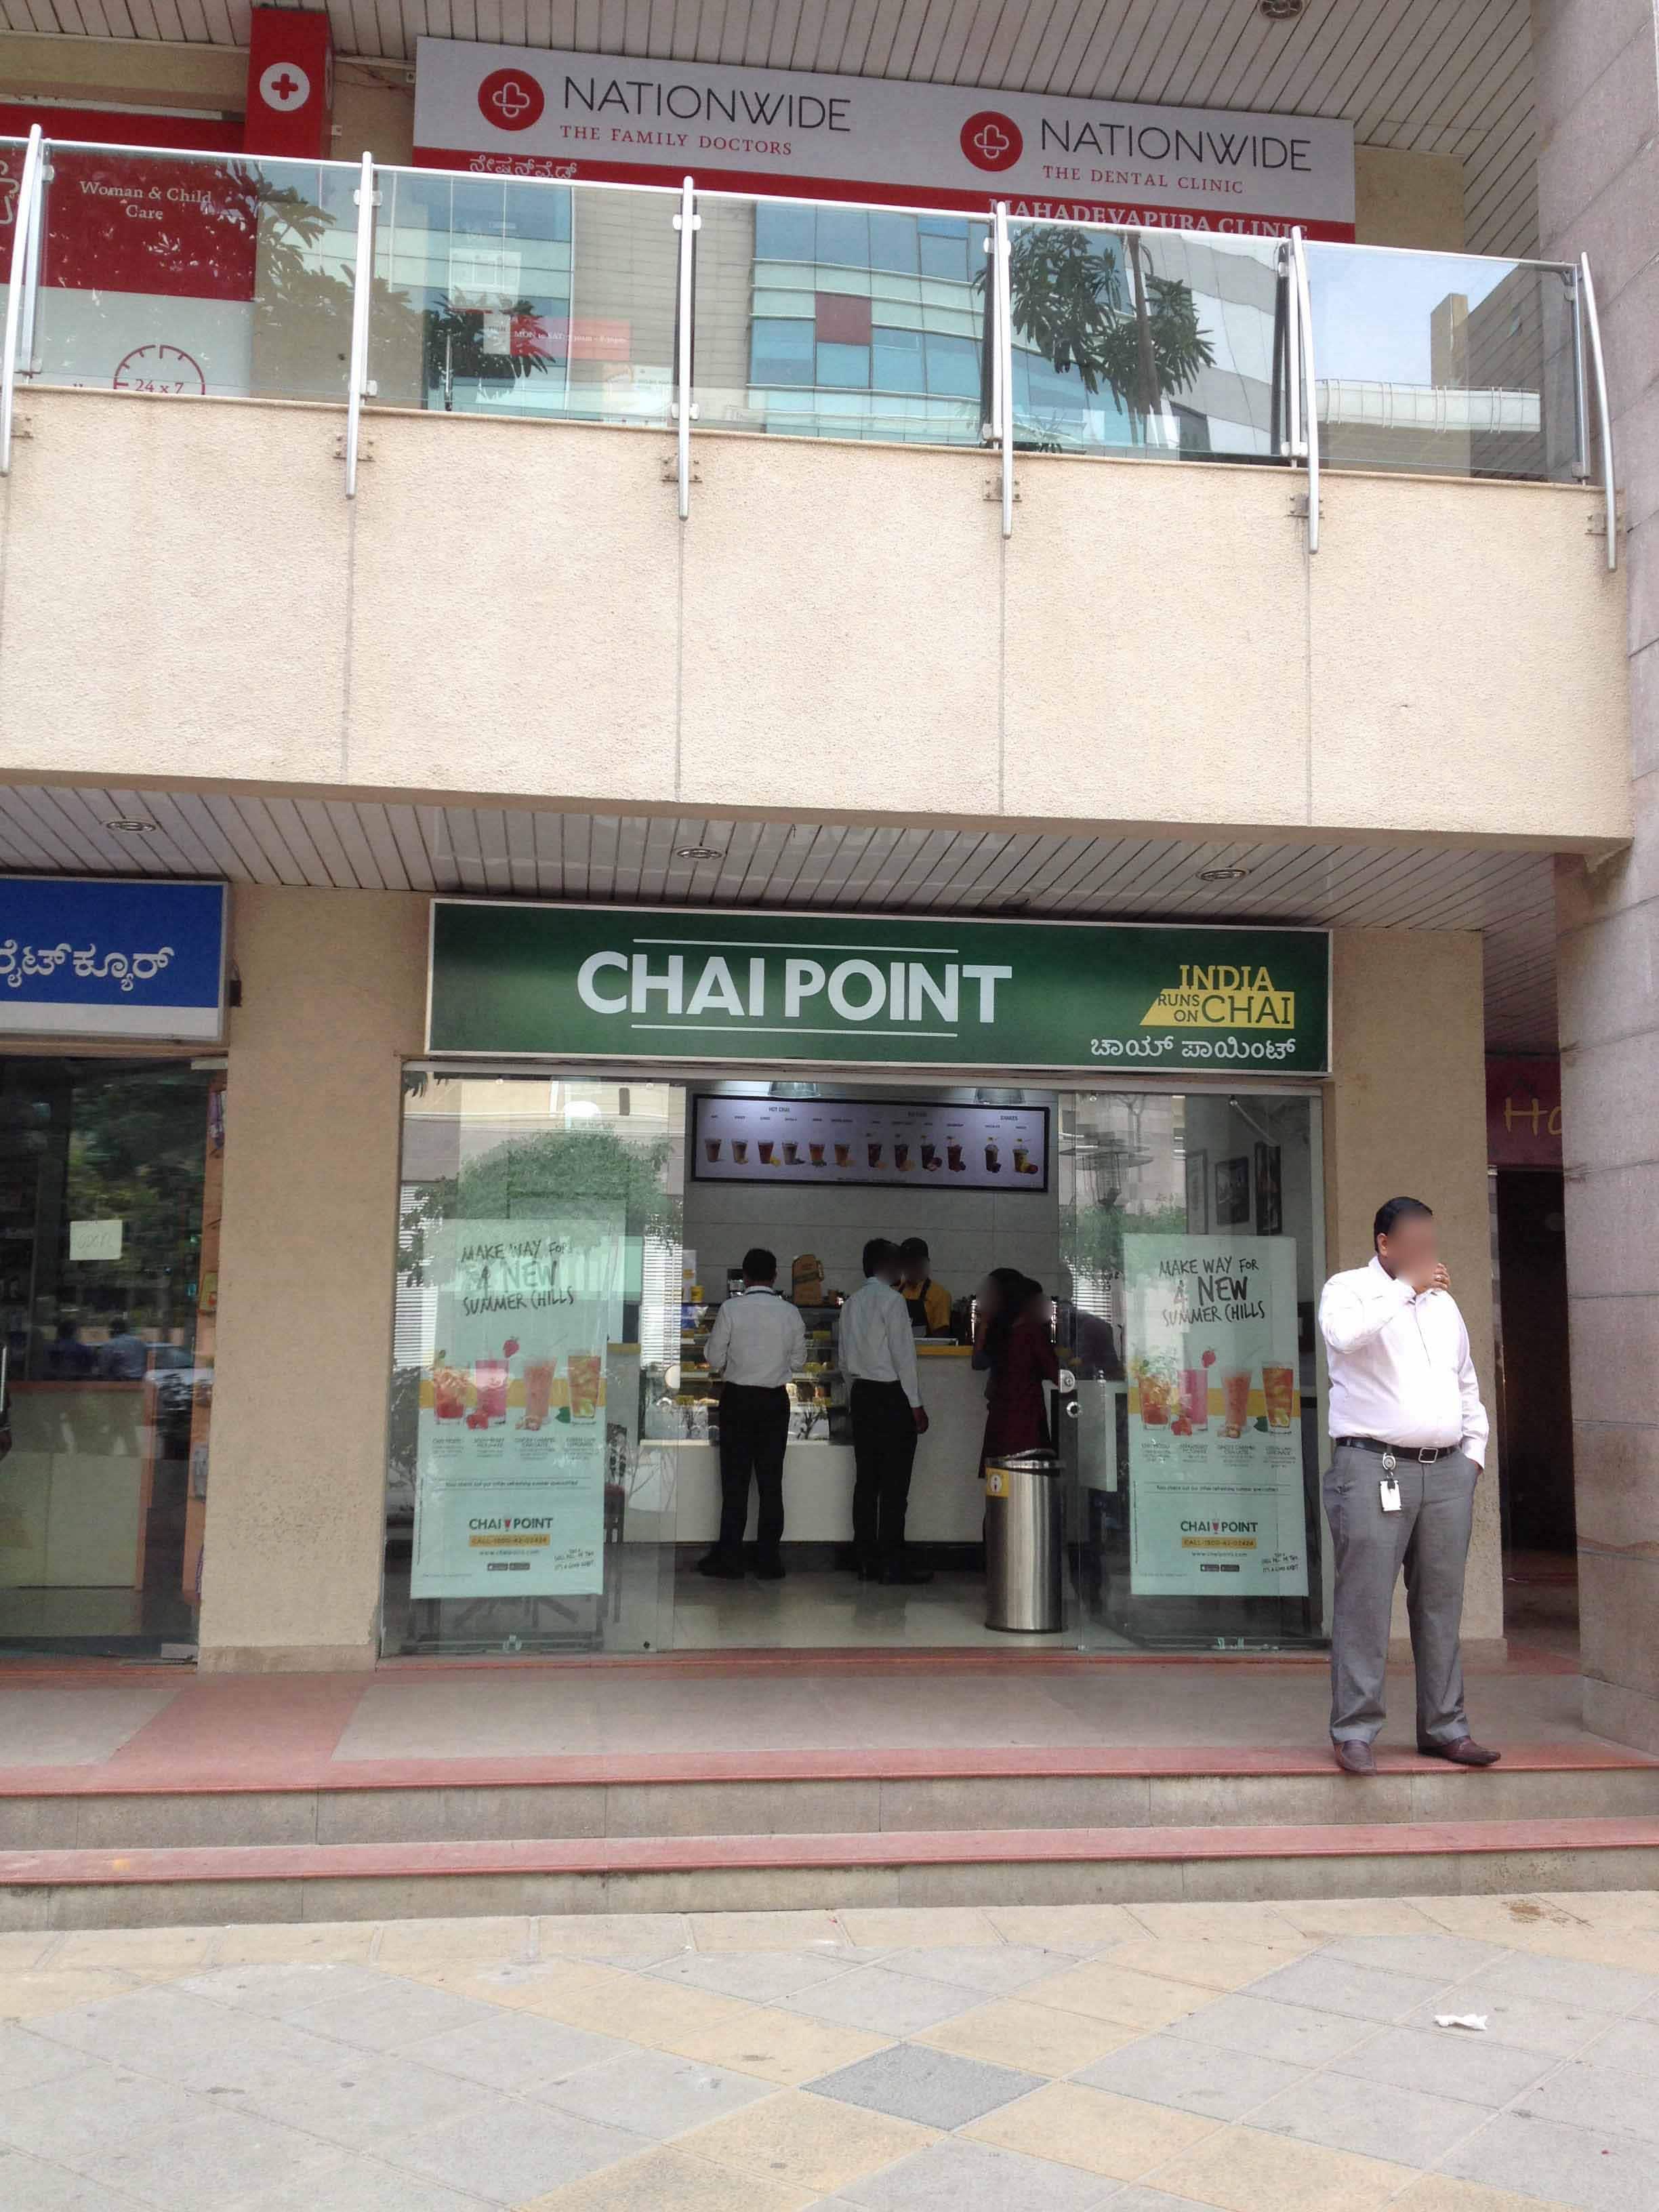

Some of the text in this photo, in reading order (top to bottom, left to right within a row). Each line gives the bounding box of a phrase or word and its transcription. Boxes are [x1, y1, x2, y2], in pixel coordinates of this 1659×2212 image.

[564, 75, 851, 131] NATIONWIDE
[560, 125, 792, 155] THE FAMILY DOCTORS
[1041, 118, 1312, 171] NATIONWIDE
[79, 180, 211, 205] Woman & Child
[1042, 165, 1244, 194] THE DENTAL CLINIC
[125, 204, 164, 220] Care
[135, 379, 155, 393] 24
[175, 382, 184, 394] 7
[577, 950, 1012, 1023] CHAI POINT
[1179, 964, 1275, 991] INDIA
[1158, 994, 1200, 1007] RUNS
[1201, 994, 1291, 1025] CHAI
[1173, 1009, 1199, 1023] ON
[460, 1243, 504, 1263] MAKE
[509, 1239, 541, 1258] WAY
[500, 1258, 557, 1293] NEW
[1159, 1255, 1260, 1277] MAKE WAY FOR
[462, 1286, 575, 1317] SUMMER CHILLS
[1197, 1275, 1248, 1306] NEW
[1162, 1300, 1265, 1327] SUMMER CHILLS
[469, 1517, 554, 1530] CHAI POINT
[1180, 1521, 1258, 1533] CHAI POINT
